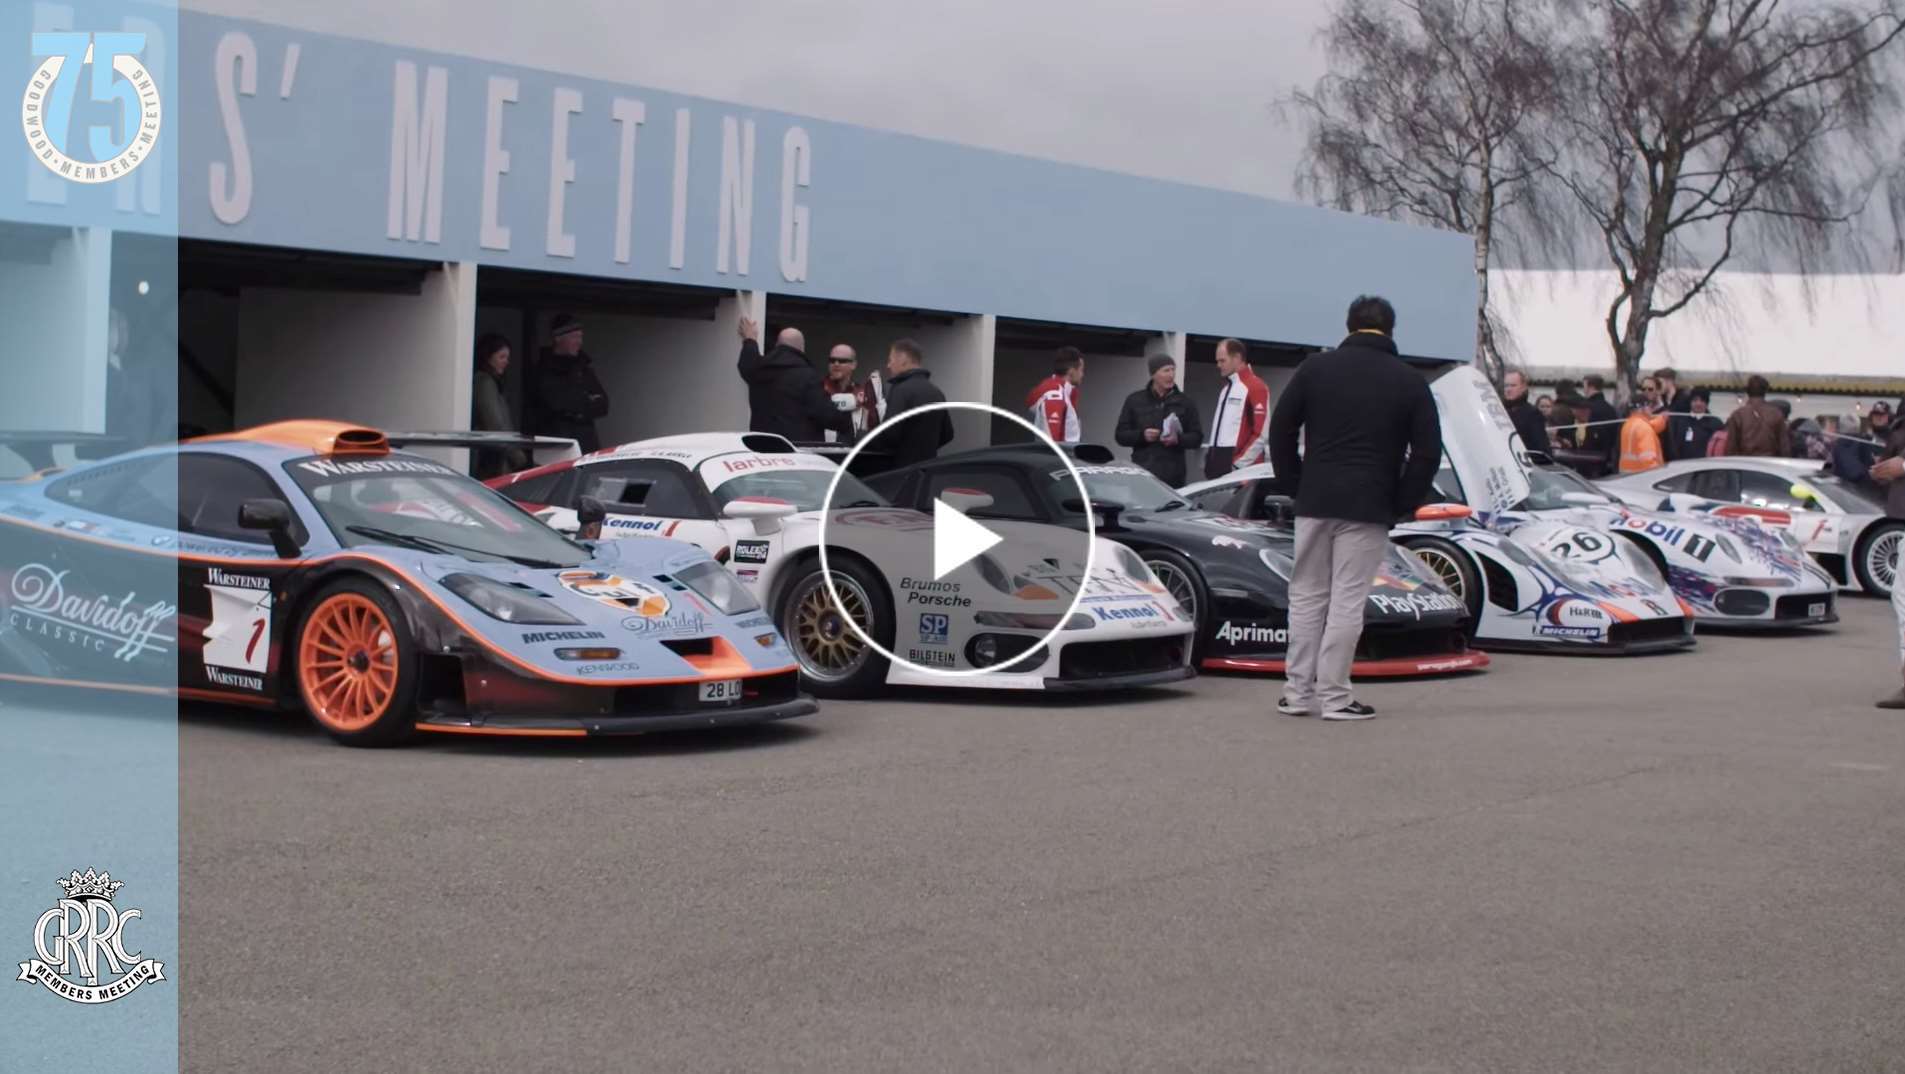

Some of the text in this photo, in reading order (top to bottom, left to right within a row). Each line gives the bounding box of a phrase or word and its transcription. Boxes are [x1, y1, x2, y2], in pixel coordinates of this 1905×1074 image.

[387, 60, 812, 283] MEETING
[1551, 532, 1602, 558] 26
[208, 567, 270, 589] WARSTEINER
[900, 577, 961, 592] Brumos
[907, 591, 972, 607] Porsche
[11, 563, 176, 661] Davidoff
[1092, 603, 1158, 620] Kennol
[10, 613, 105, 651] CLASSIC
[921, 615, 946, 633] SP
[1543, 628, 1598, 637] MICHELIN
[252, 617, 266, 664] 1
[522, 631, 605, 644] MICHELIN
[909, 648, 955, 663] BILSTEIN
[707, 683, 724, 698] 28
